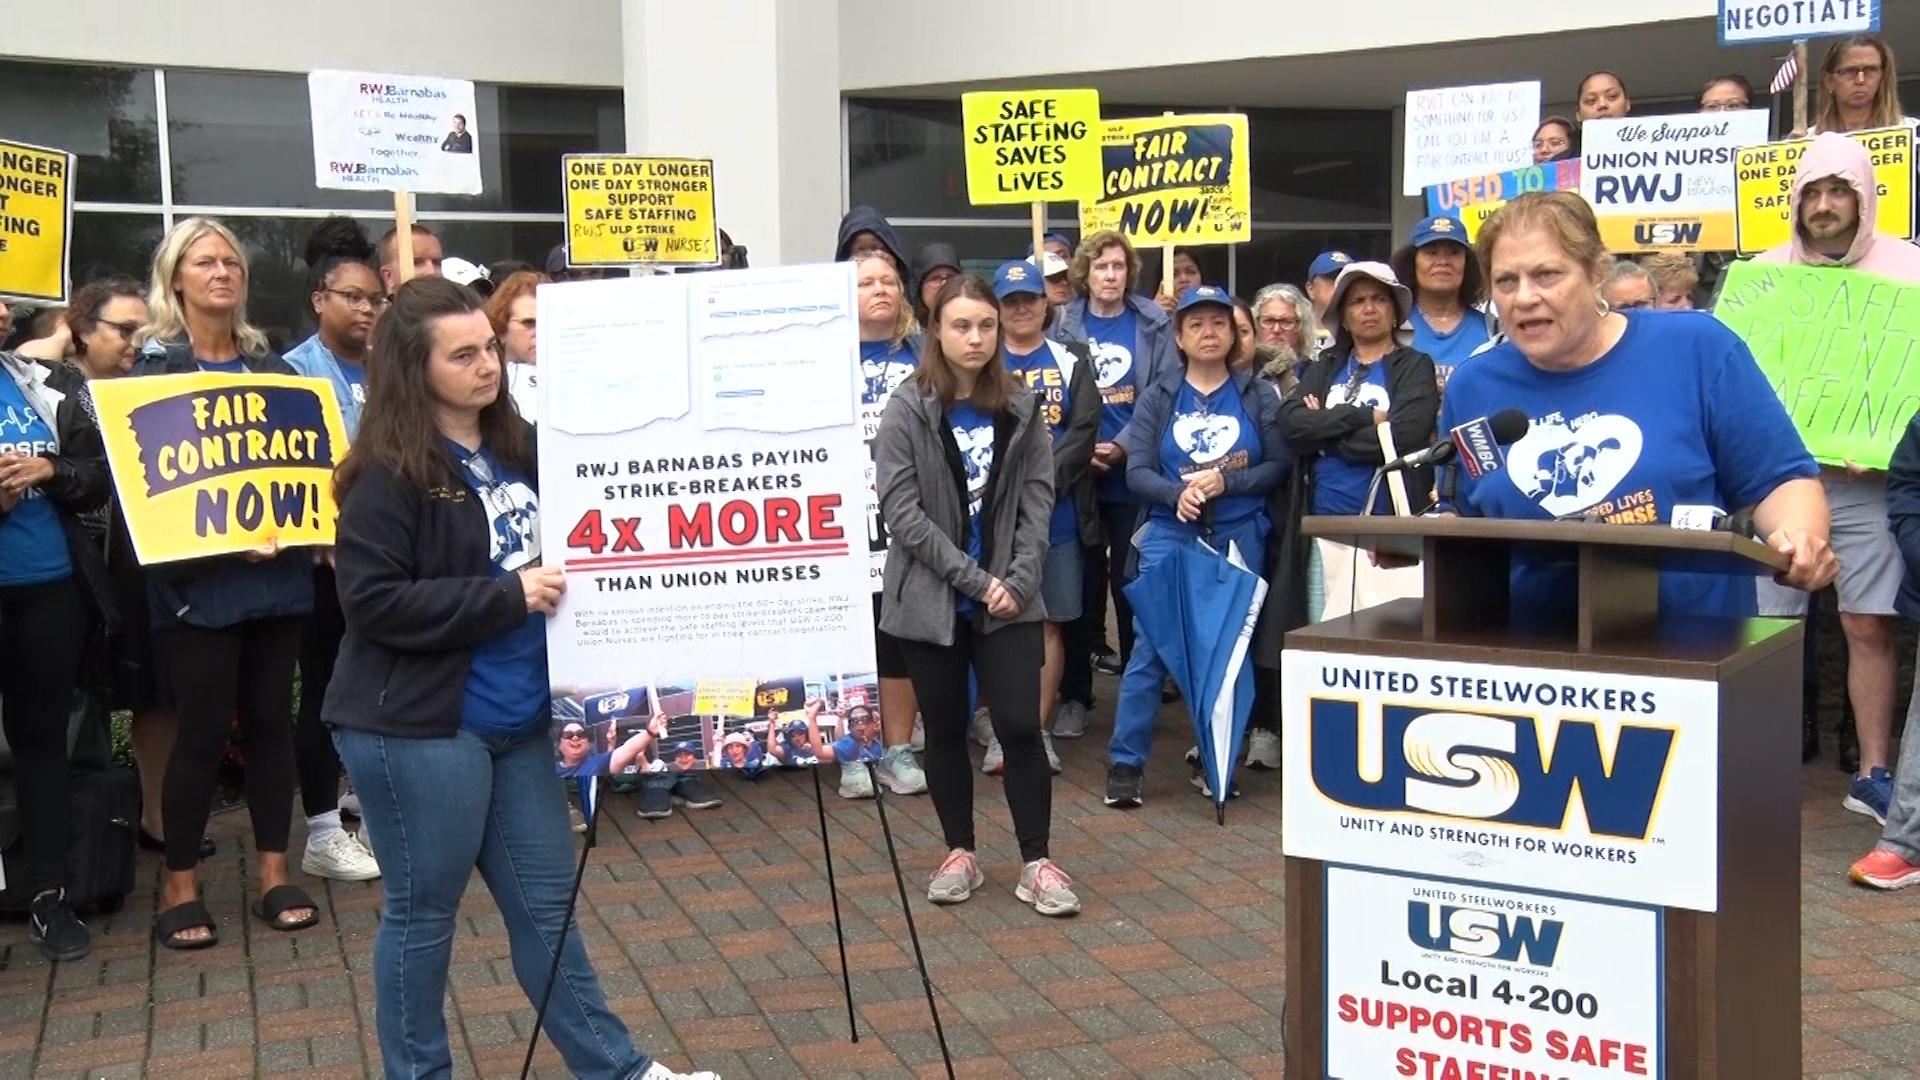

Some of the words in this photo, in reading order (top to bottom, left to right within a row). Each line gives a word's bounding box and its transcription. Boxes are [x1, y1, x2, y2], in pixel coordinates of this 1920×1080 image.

[1727, 0, 1867, 30] NEGOTIATE
[1000, 99, 1057, 120] SAFE
[1134, 131, 1188, 161] FAIR
[1499, 129, 1511, 144] A
[1616, 124, 1648, 143] We
[1651, 121, 1730, 144] Support
[0, 151, 62, 178] NGER
[571, 163, 606, 176] ONE
[612, 163, 643, 176] DAY
[649, 163, 710, 177] LONGER
[995, 145, 1067, 166] SAVES
[1586, 151, 1658, 170] UNION
[1665, 147, 1736, 166] NURS
[1742, 150, 1778, 166] ONE
[0, 175, 57, 198] NGER
[570, 179, 600, 190] ONE
[605, 179, 633, 190] DAY
[637, 179, 708, 192] STRONGER
[1106, 157, 1223, 195] CONTRACT
[1436, 172, 1502, 210] USED
[1516, 165, 1545, 194] TO
[1595, 172, 1683, 204] RWJ
[1739, 168, 1770, 182] ONE
[1777, 165, 1797, 177] DA
[584, 208, 624, 220] SAFE
[628, 208, 697, 221] STAFFING
[608, 193, 675, 206] SUPPORT
[609, 225, 633, 235] ULP
[636, 225, 676, 235] STRIKE
[1119, 197, 1209, 236] NOW!
[1214, 223, 1242, 232] UW
[1634, 222, 1702, 244] USW
[1724, 267, 1785, 313] NOW!
[1790, 273, 1913, 332] SAFE
[1746, 318, 1920, 388] PATIENT
[192, 391, 268, 431] FAIR
[1775, 377, 1920, 443] AFFING
[158, 428, 320, 481] CONTRACT
[1467, 422, 1498, 471] WMBC
[576, 461, 619, 479] RWJ
[628, 453, 744, 475] BARNABAS
[752, 448, 829, 466] PAYING
[604, 473, 802, 500] STRIKE-BREAKERS
[1616, 489, 1654, 510] LIVES
[194, 482, 320, 536] NOW!
[566, 509, 645, 554] 4x
[668, 493, 844, 549] MORE
[594, 575, 652, 592] THAN
[661, 569, 727, 588] UNION
[736, 564, 821, 583] NURSES
[1322, 667, 1419, 694] UNITED
[1430, 675, 1657, 715] STEELWORKERS
[1309, 696, 1680, 842] USW
[1339, 815, 1385, 834] UNITY
[1390, 821, 1424, 839] AND
[1429, 826, 1509, 849] STRENGTH
[1515, 836, 1547, 854] FOR
[1552, 841, 1638, 864] WORKERS
[1413, 887, 1457, 903] UNITED
[1461, 893, 1557, 916] STEELWORKERS
[1407, 900, 1565, 968] USW
[1381, 960, 1478, 999] Local
[1492, 979, 1599, 1019] 4-200
[1337, 993, 1533, 1053] SUPPORTS
[1545, 1030, 1649, 1076] SAFE
[1396, 1047, 1570, 1080] STAFF
